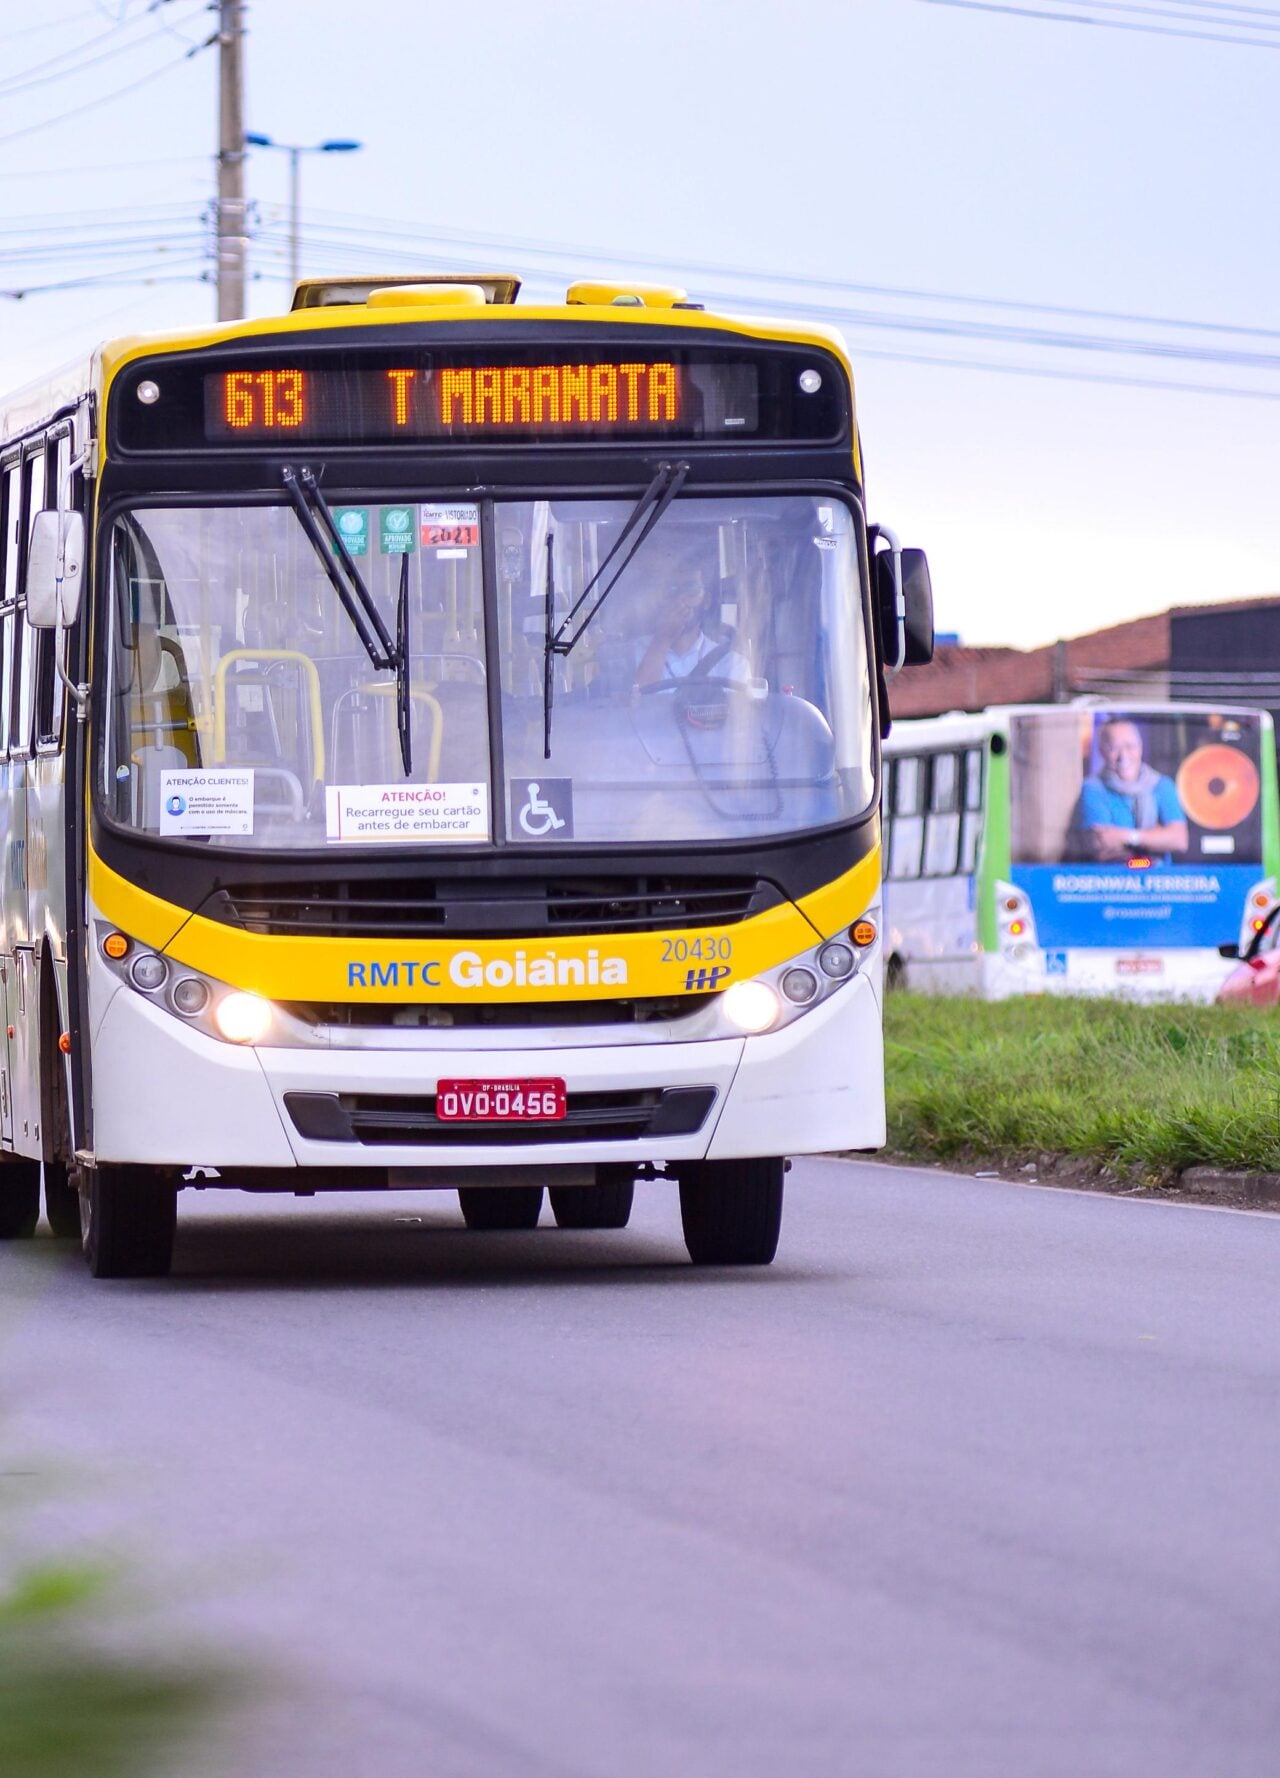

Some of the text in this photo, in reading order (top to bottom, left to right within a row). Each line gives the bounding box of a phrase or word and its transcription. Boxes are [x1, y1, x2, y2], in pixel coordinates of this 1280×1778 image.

[226, 363, 676, 427] 613 T MARANATA
[166, 777, 206, 786] ATENÇÃO
[381, 789, 446, 803] ATENÇÃO!
[346, 805, 481, 819] Recarregue seu cartão
[358, 819, 470, 830] antes de embarcar
[661, 937, 732, 962] 20430
[348, 962, 441, 987] RMTC
